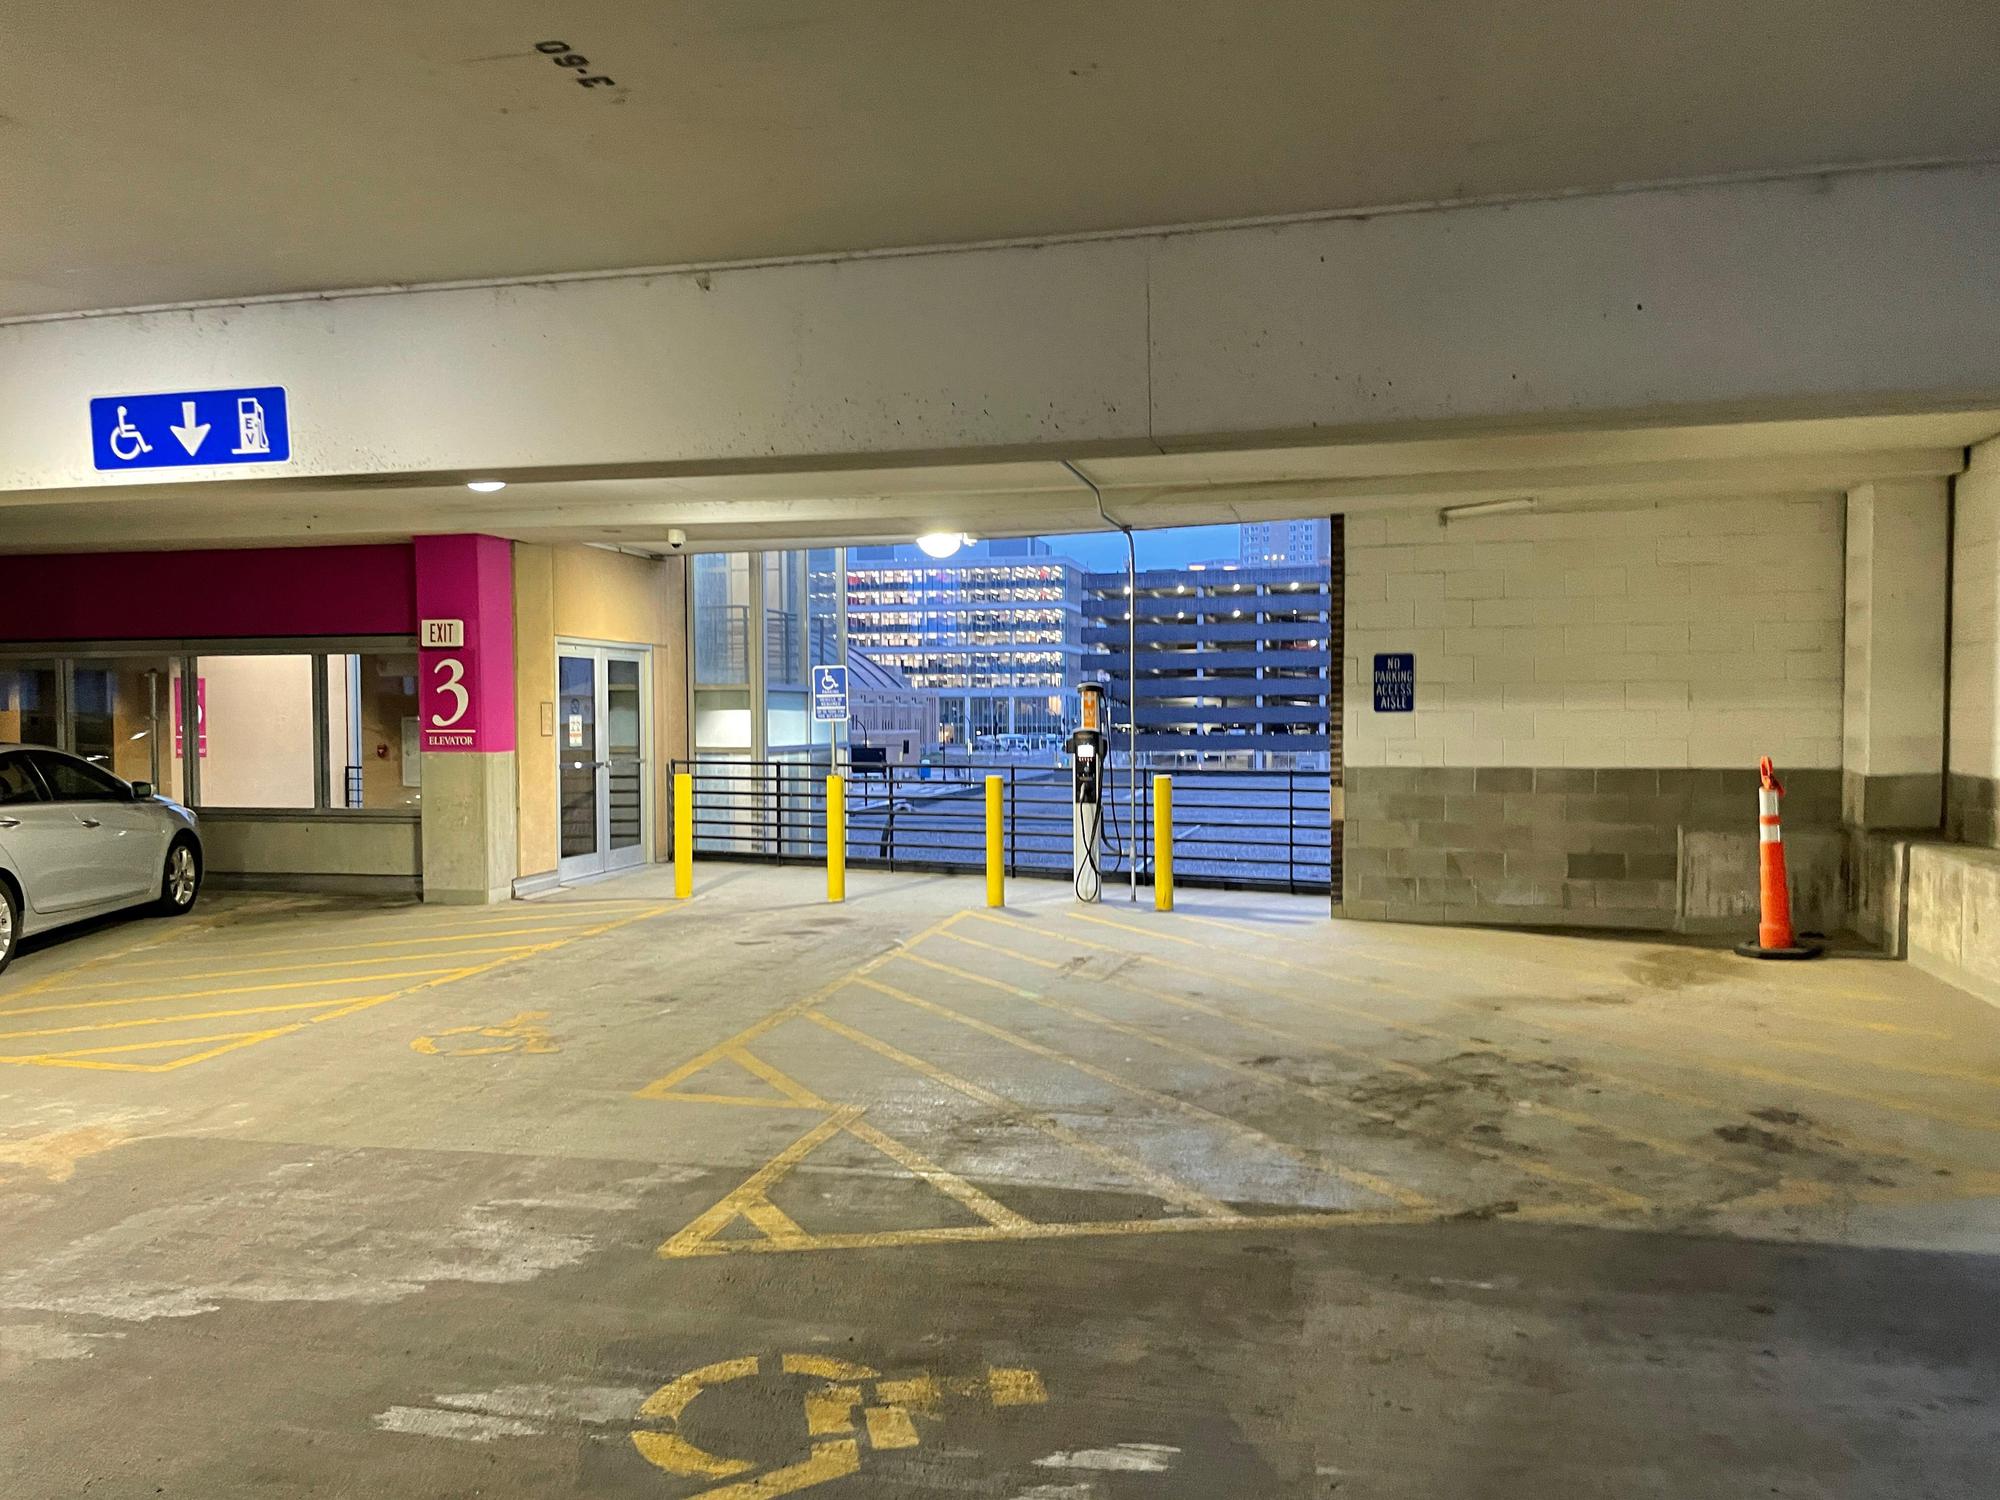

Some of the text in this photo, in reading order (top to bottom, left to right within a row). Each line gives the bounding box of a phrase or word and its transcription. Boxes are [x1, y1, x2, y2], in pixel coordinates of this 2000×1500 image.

[429, 623, 454, 643] EXIT
[1387, 656, 1400, 670] NO
[1375, 670, 1412, 683] PARKING
[432, 658, 469, 727] 3
[1376, 684, 1412, 697] ACCESS
[1380, 696, 1407, 710] AISLE
[429, 736, 473, 745] ELEVATOR
